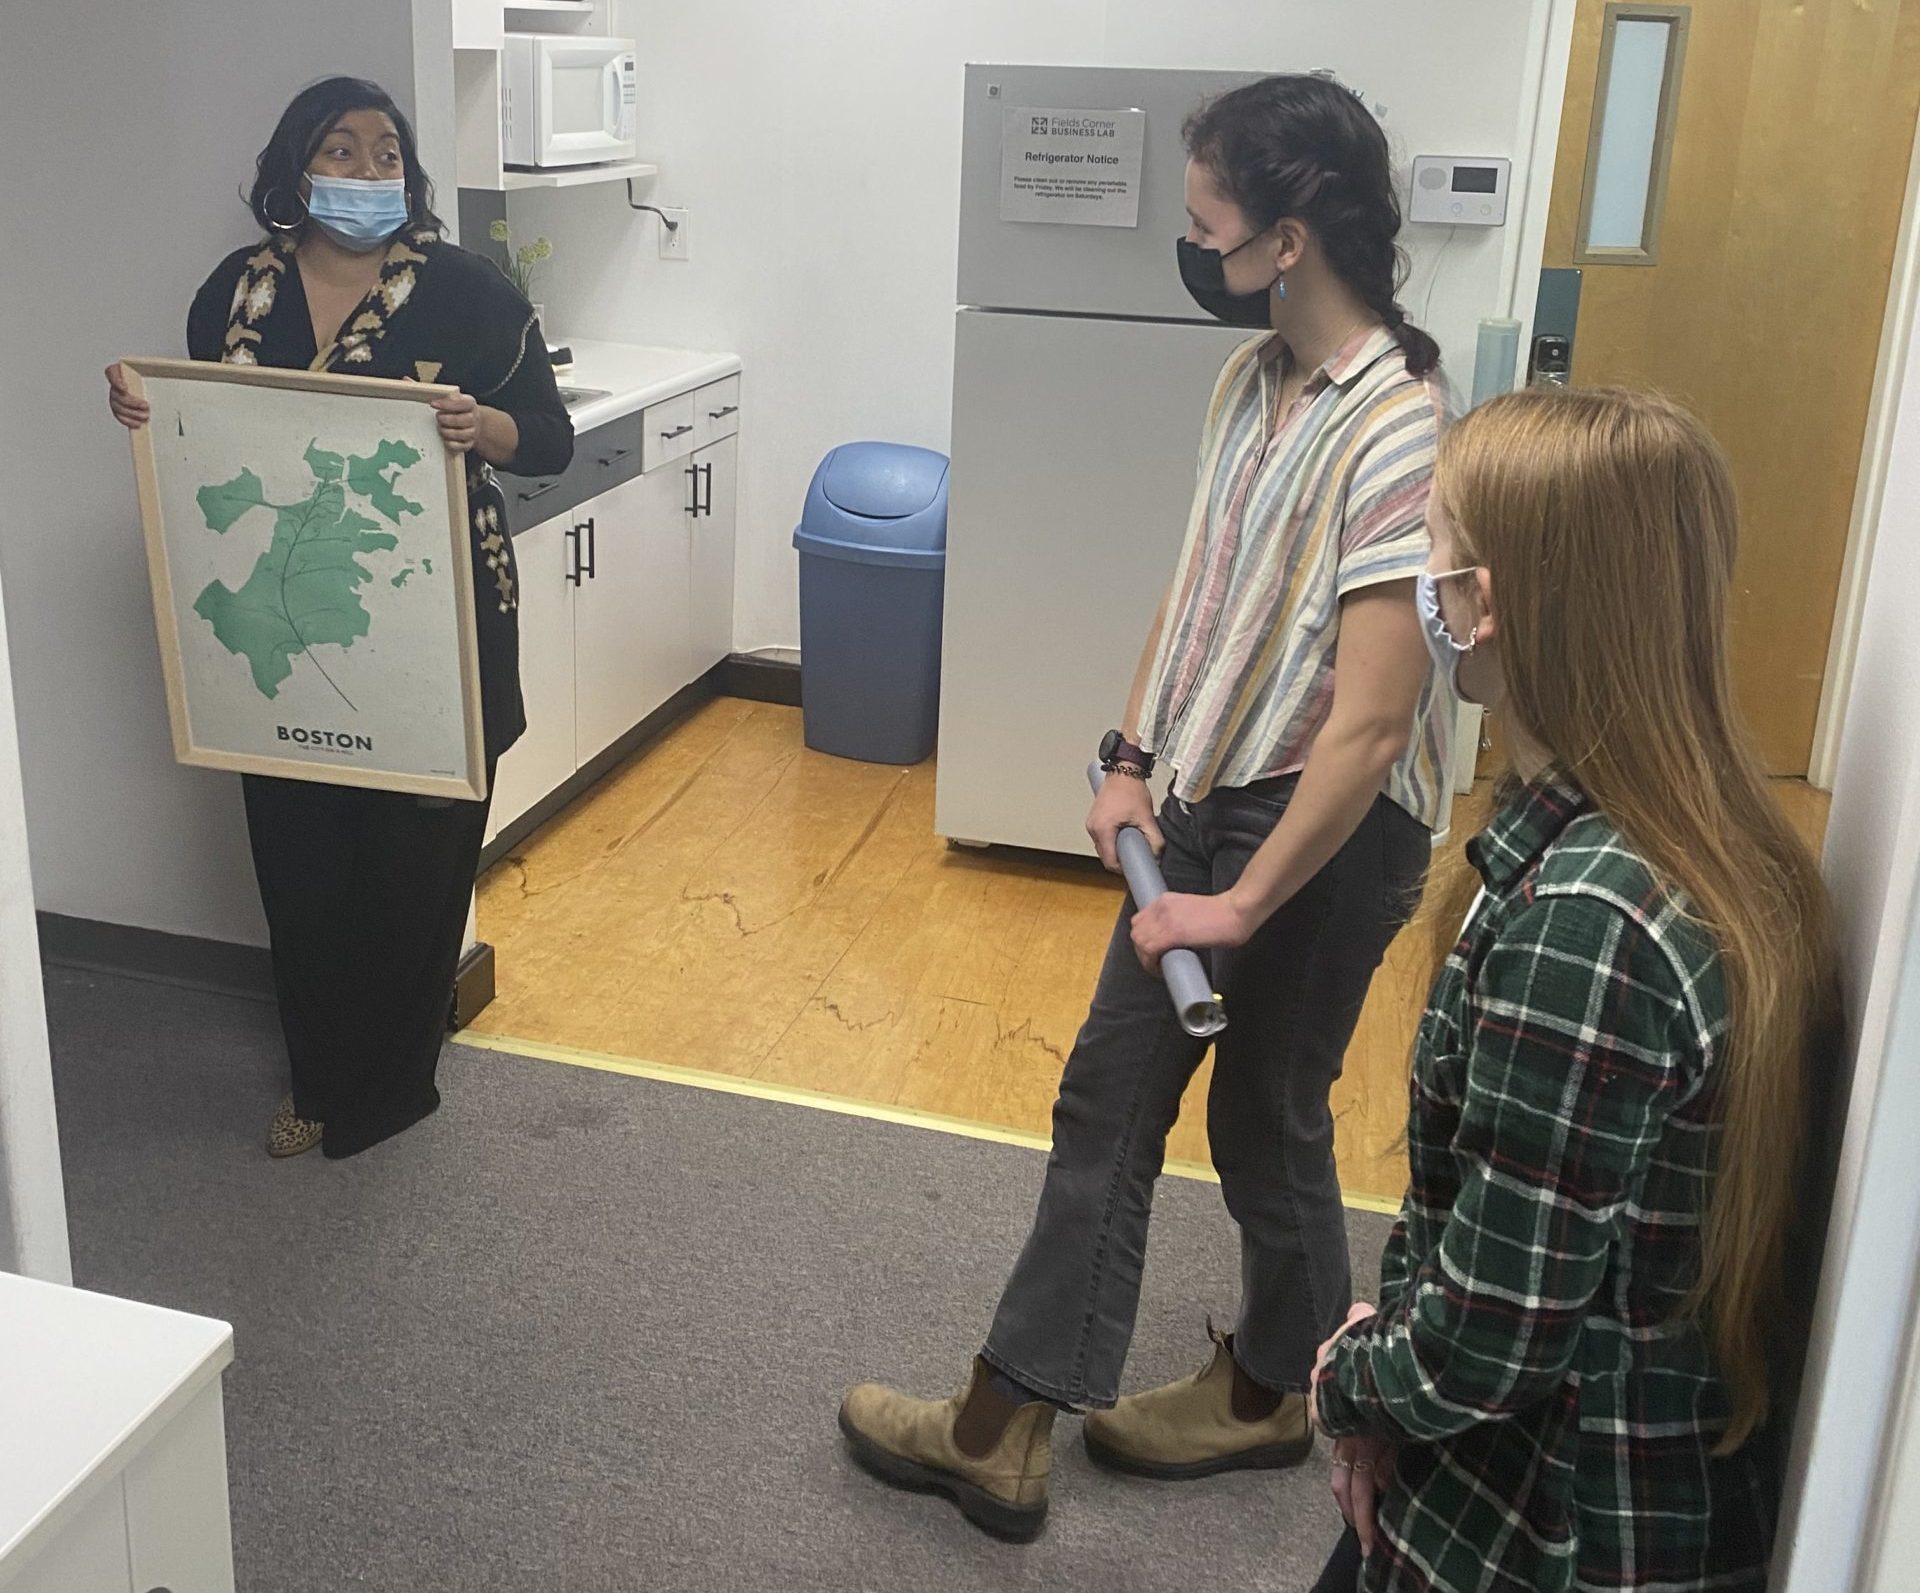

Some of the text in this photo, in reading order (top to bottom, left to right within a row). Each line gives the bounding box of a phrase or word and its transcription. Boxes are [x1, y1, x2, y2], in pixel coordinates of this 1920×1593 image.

[1051, 117, 1116, 129] Fields Corner
[1051, 127, 1115, 138] BUSINESS LAB
[1025, 151, 1119, 165] Refrigerator Notice
[276, 725, 373, 751] BOSTON
